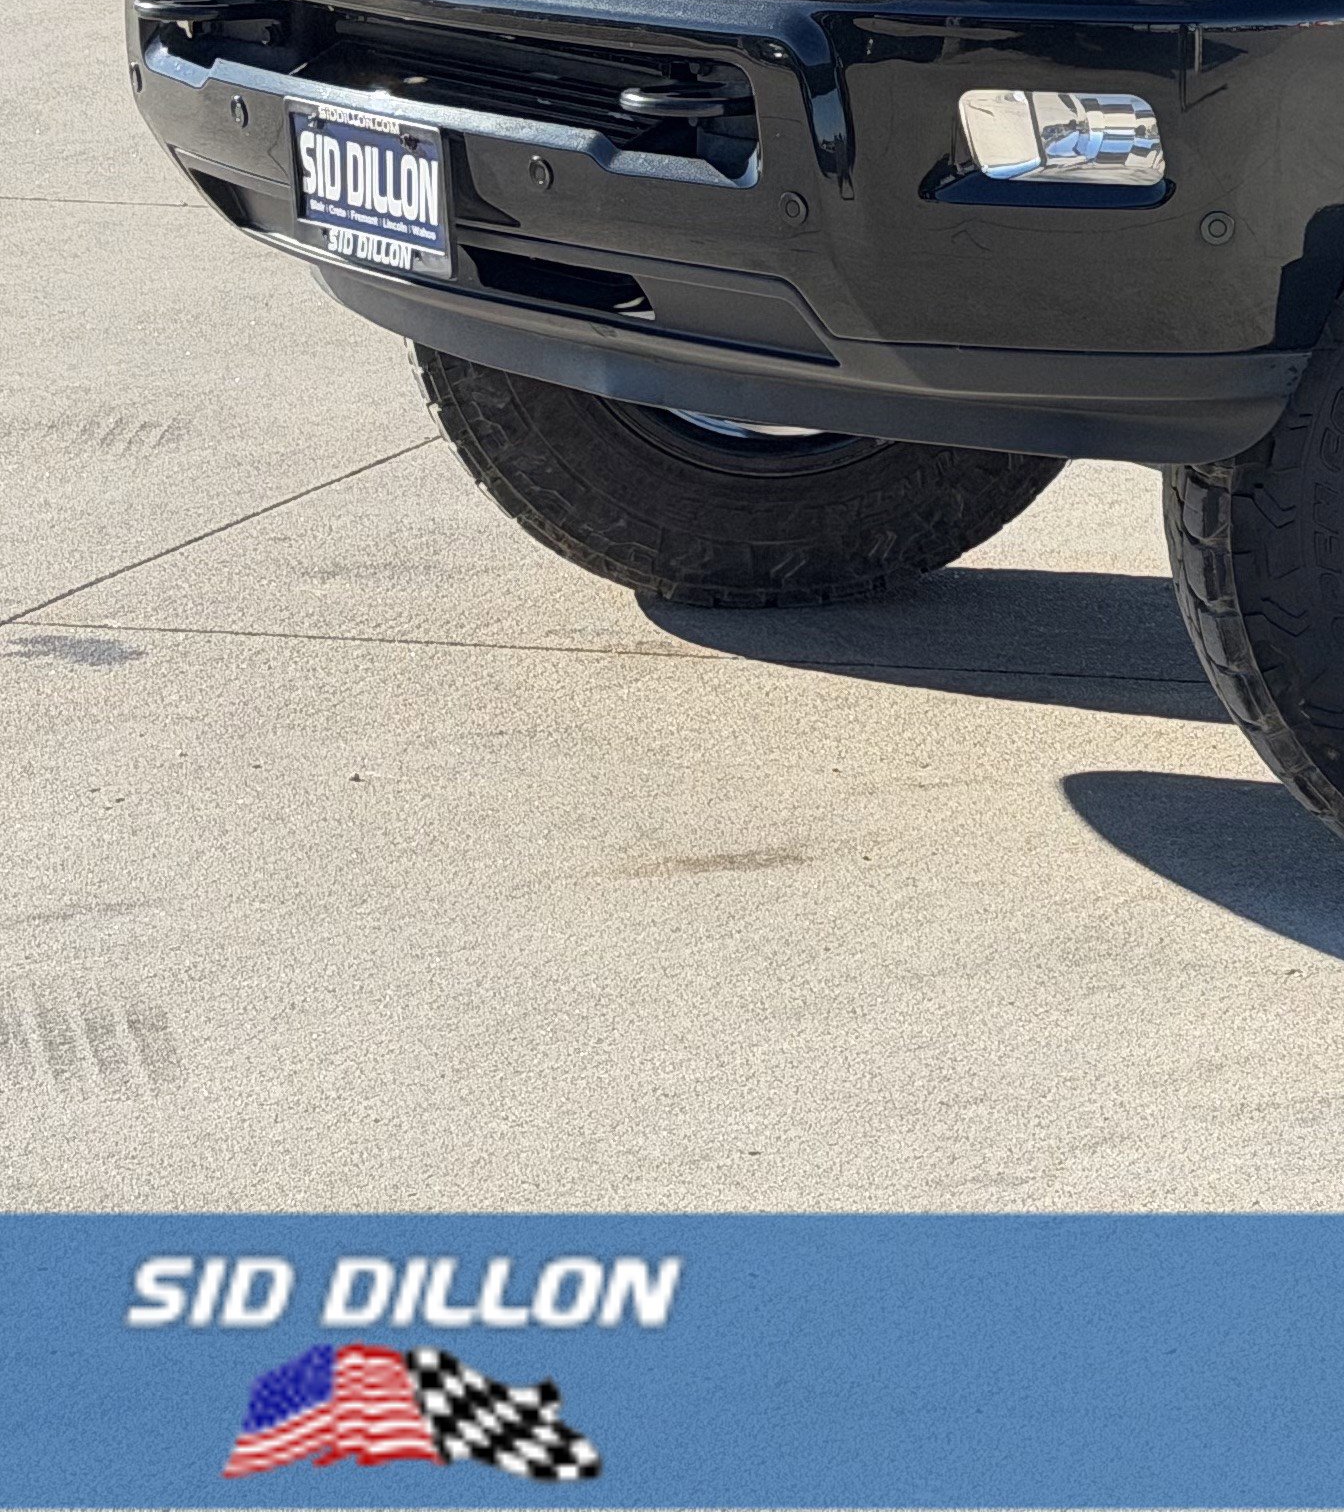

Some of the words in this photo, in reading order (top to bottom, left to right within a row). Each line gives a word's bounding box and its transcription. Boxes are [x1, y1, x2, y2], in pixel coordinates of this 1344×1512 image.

[300, 131, 342, 202] SID
[346, 140, 439, 226] DILLON
[328, 229, 353, 256] SID
[356, 234, 413, 270] DILLON
